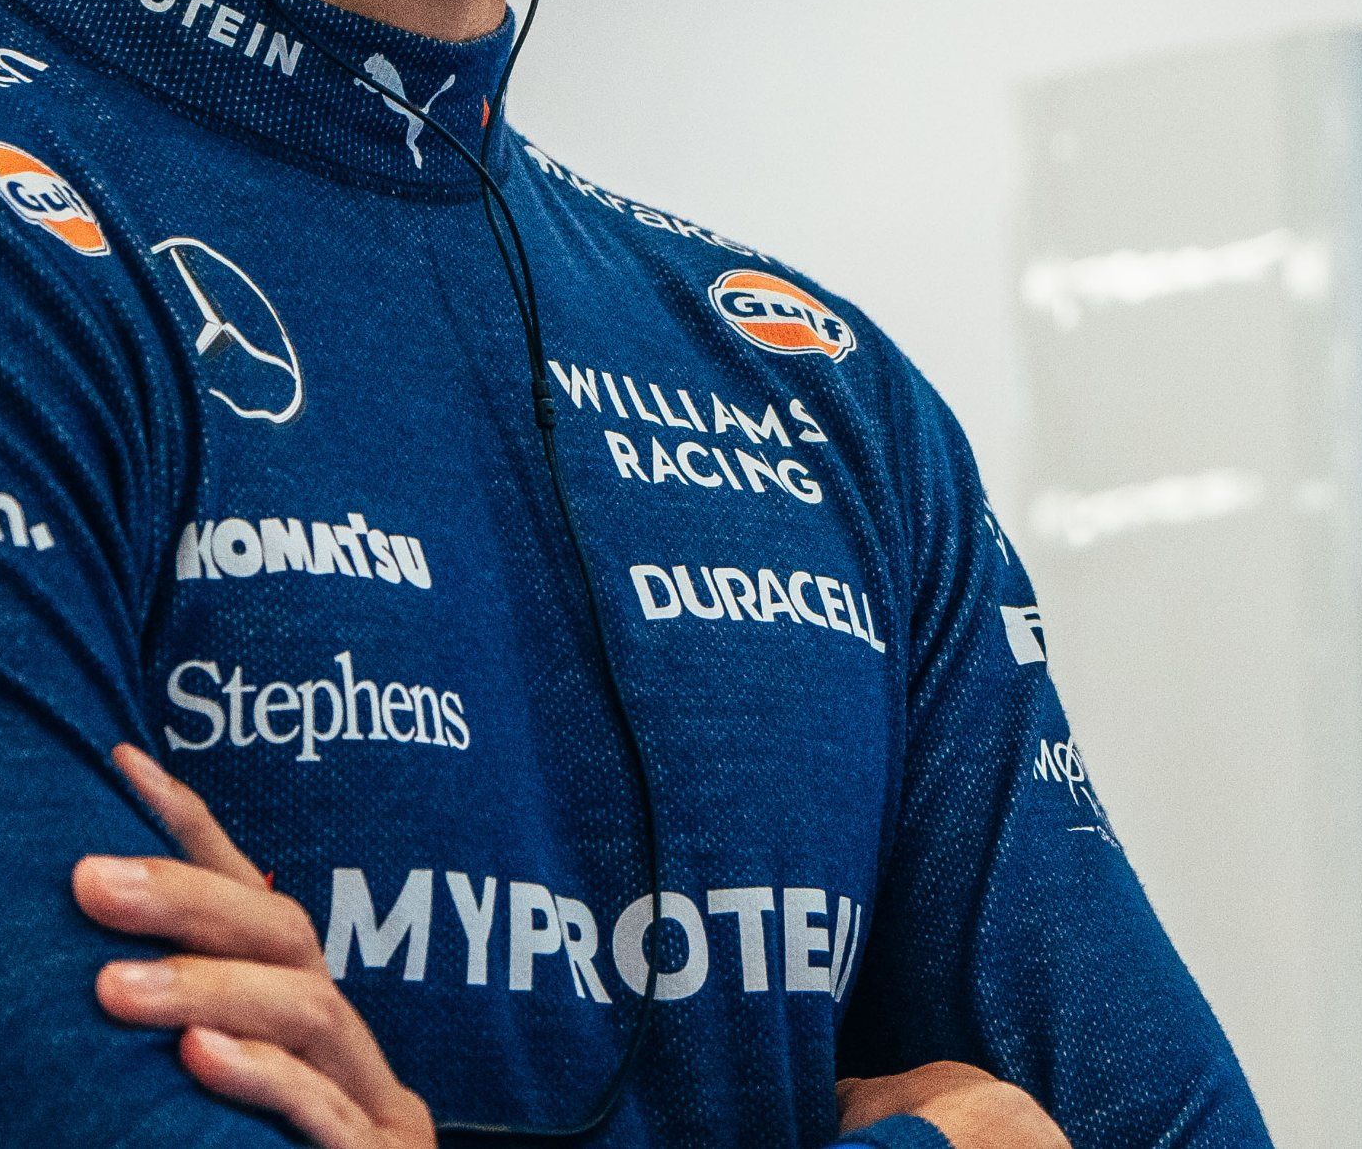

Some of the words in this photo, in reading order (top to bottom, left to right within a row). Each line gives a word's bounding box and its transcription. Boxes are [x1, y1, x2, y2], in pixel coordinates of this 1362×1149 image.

[720, 291, 843, 342] Gulf
[547, 360, 828, 447] WILLIAMS
[604, 430, 823, 504] RACING
[176, 512, 432, 589] KOMATSU
[629, 564, 886, 653] DURACELL
[163, 651, 471, 762] Stephens
[324, 867, 861, 1003] MYPROTEI
